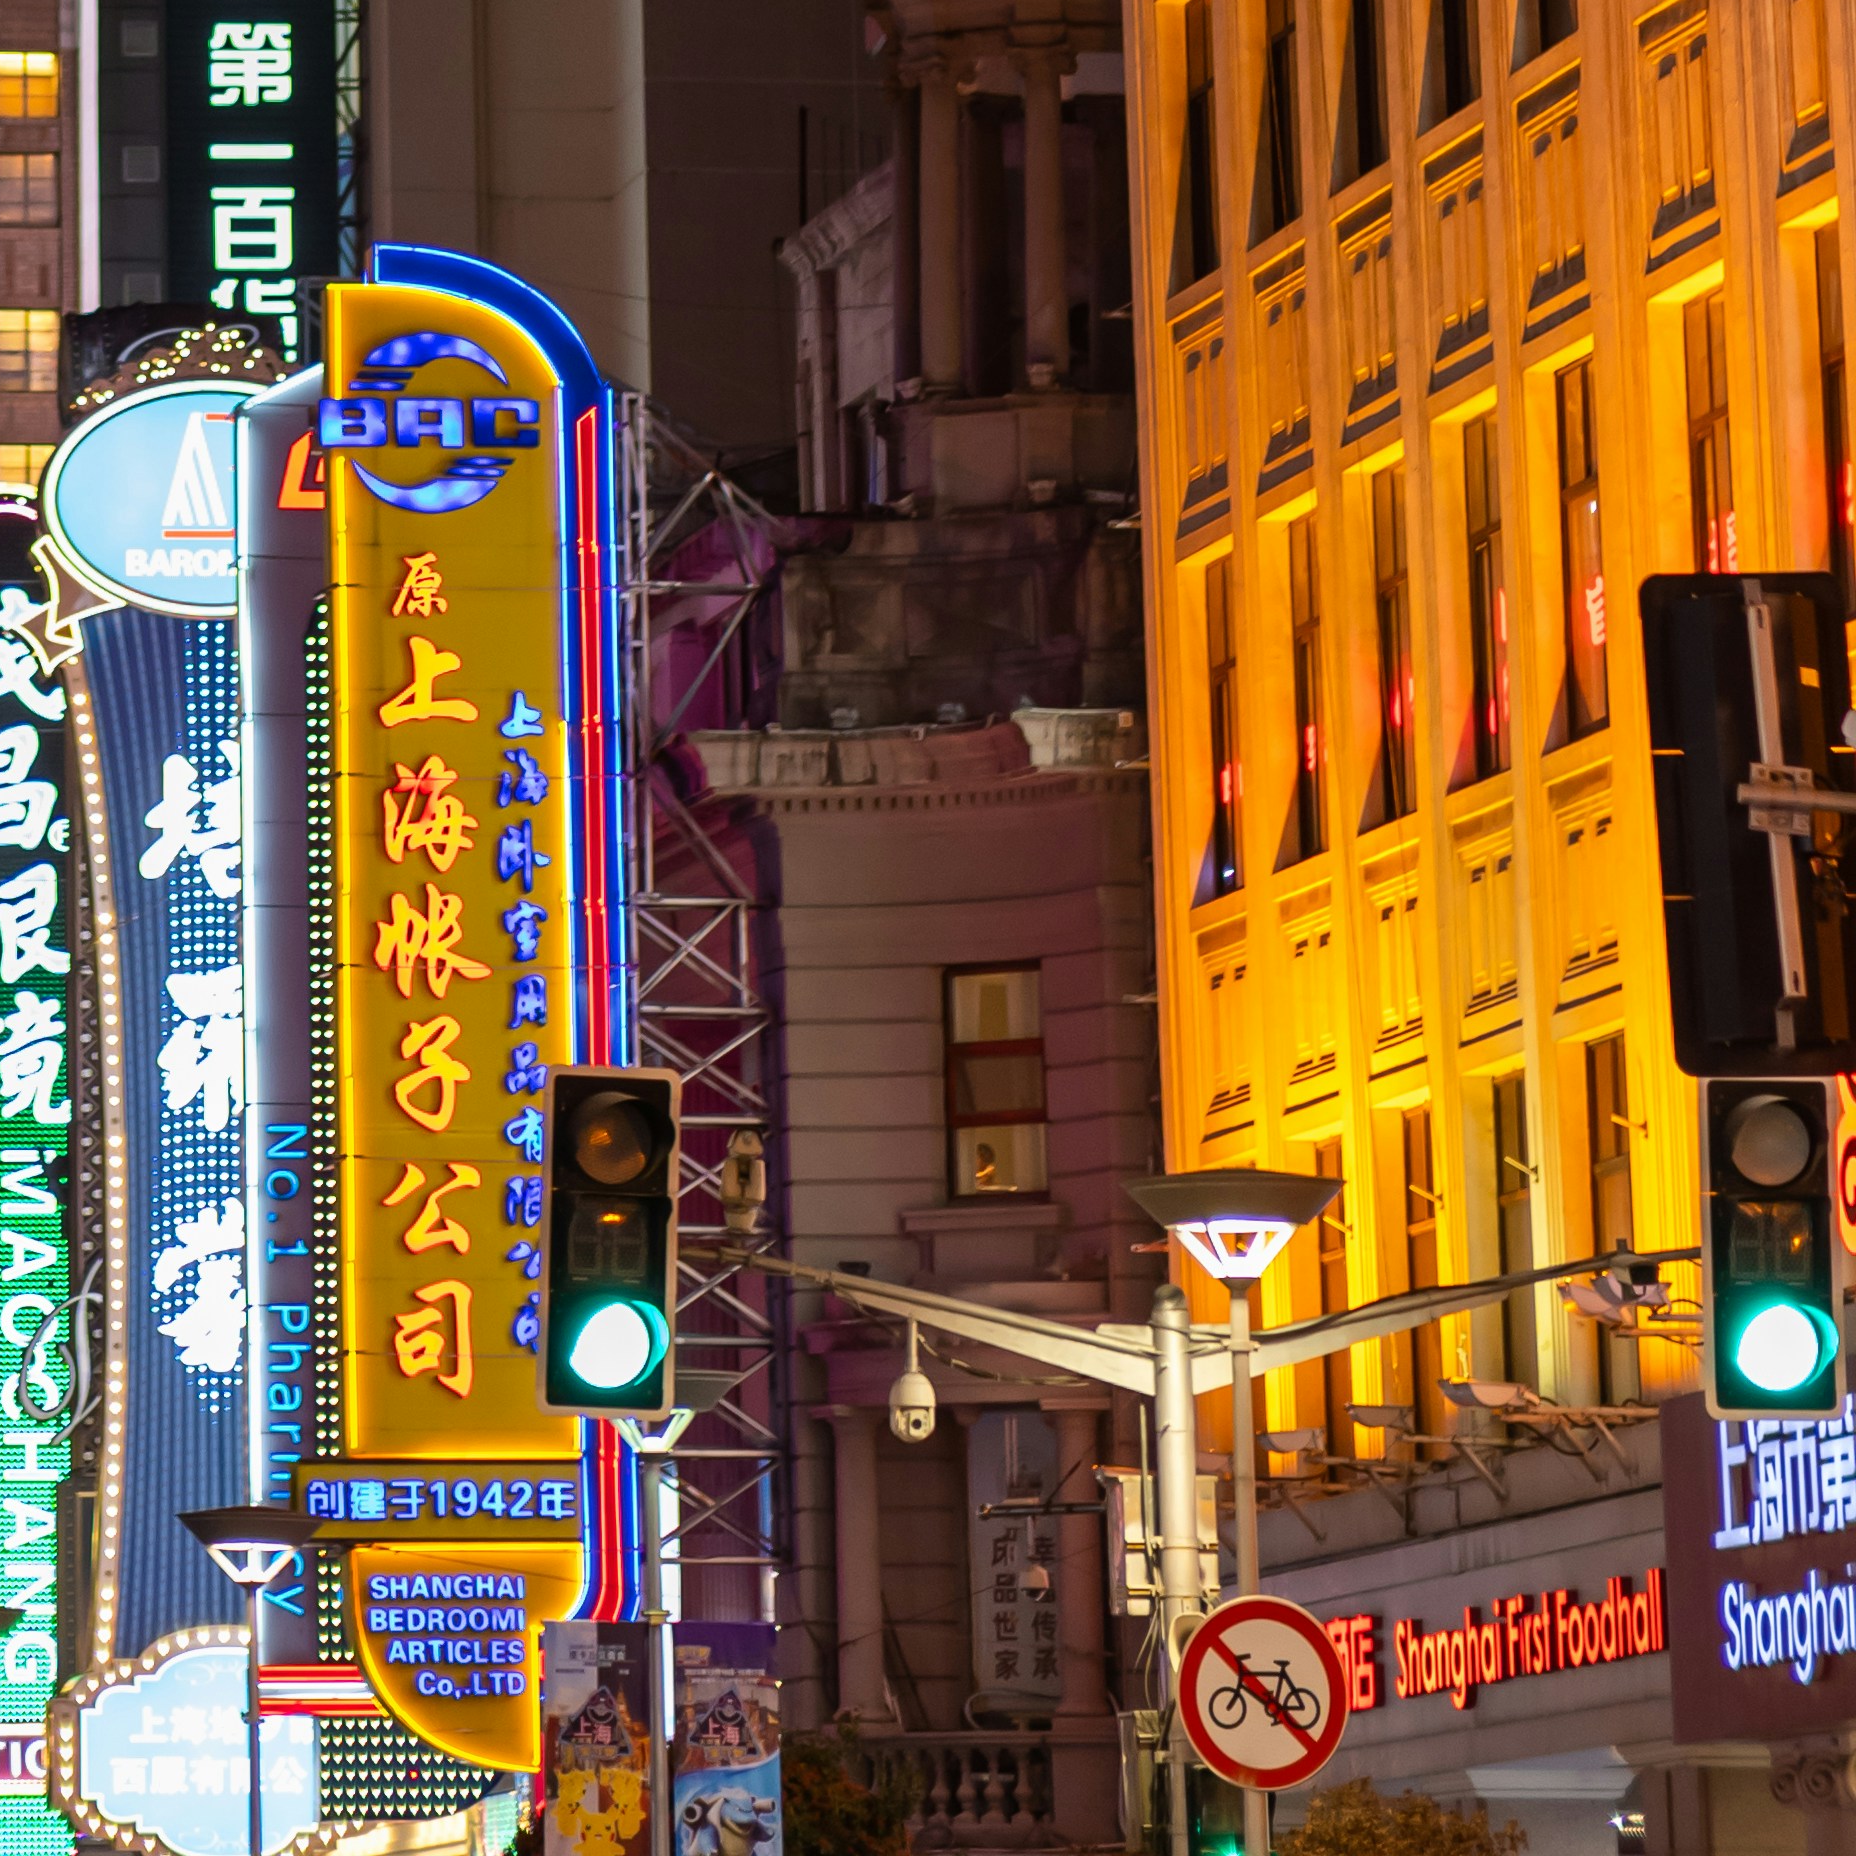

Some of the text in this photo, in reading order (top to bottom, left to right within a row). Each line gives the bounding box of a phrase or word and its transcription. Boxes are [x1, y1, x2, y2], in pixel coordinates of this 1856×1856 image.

[319, 397, 540, 449] BAC
[265, 1123, 312, 1616] No.1 Pharcy
[307, 1478, 577, 1521] 创建于1942年
[370, 1575, 525, 1600] SHANGHAI
[1027, 1536, 1058, 1681] 幸传承
[1721, 1562, 1856, 1686] Shanghai
[388, 1640, 525, 1664] ARTICLES
[1396, 1567, 1664, 1710] Shanghai First Foodhall
